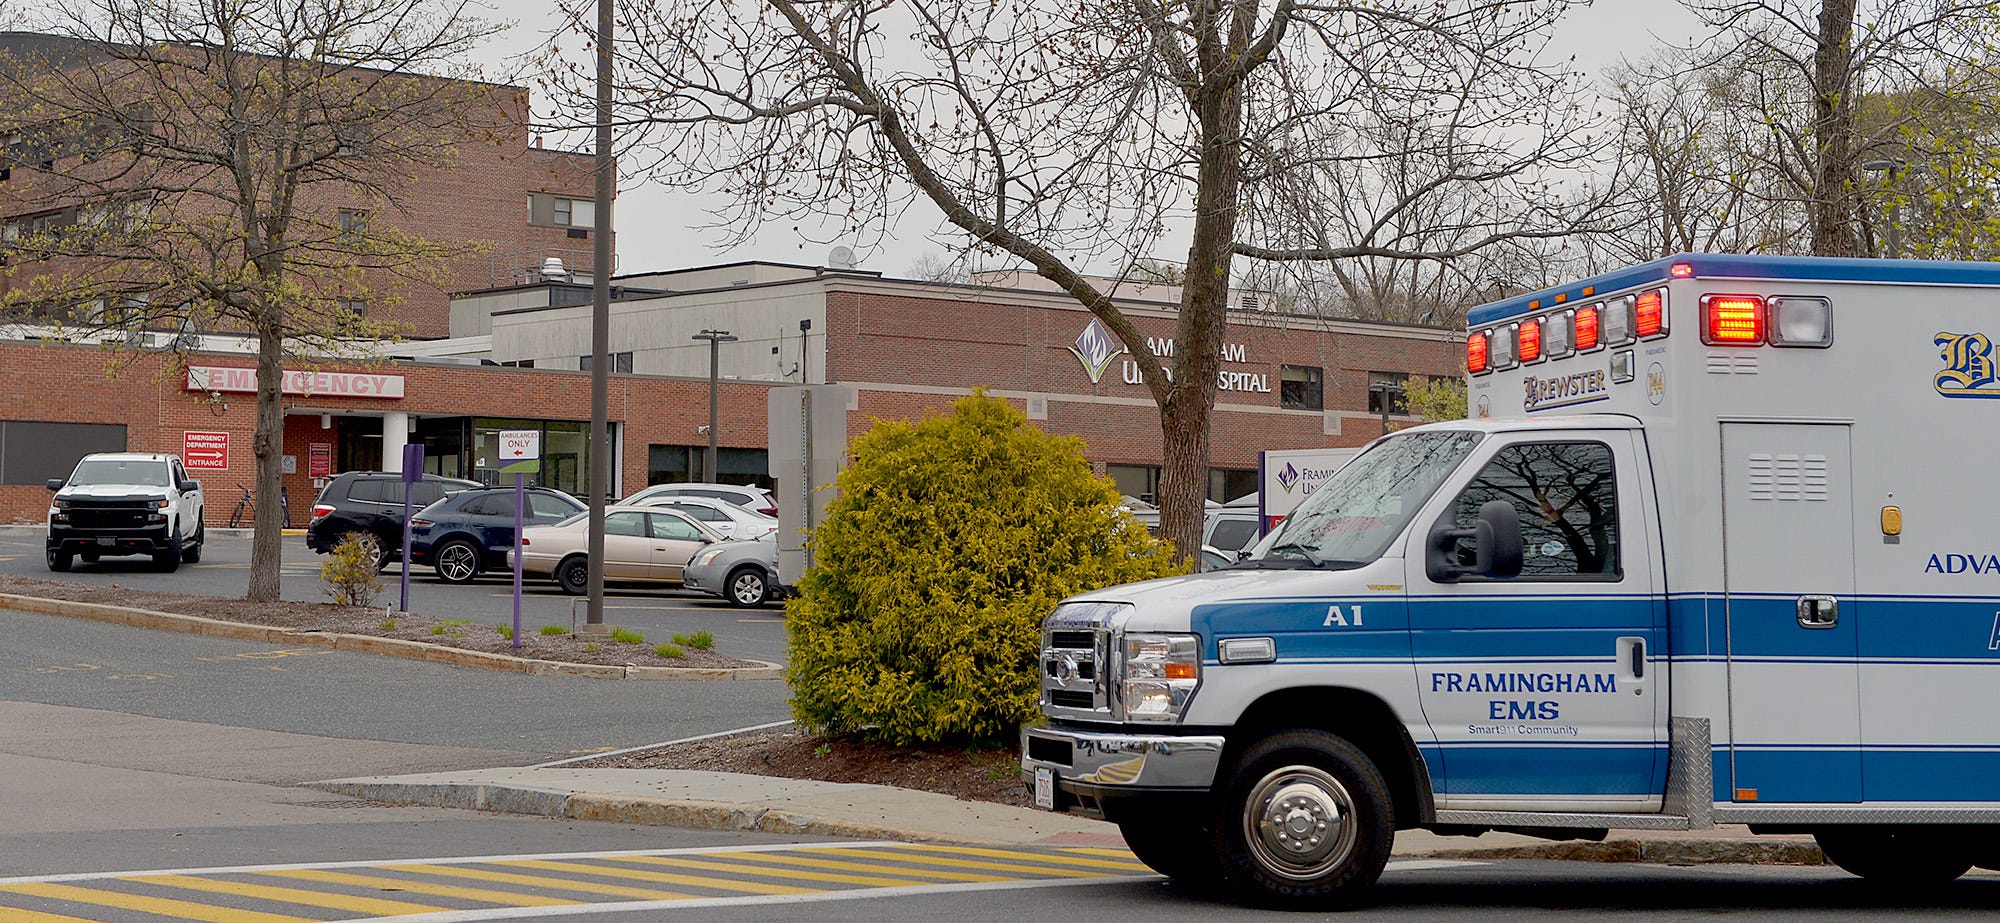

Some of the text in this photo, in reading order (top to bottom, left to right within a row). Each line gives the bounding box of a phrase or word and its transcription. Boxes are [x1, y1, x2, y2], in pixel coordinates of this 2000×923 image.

[1217, 371, 1271, 393] SPITAL
[1524, 370, 1606, 412] BREWSTER
[186, 441, 227, 449] DEPARTMENT
[187, 434, 226, 442] EMERGENCY
[507, 440, 530, 448] ONLY
[188, 459, 224, 467] ENTRANCE
[1322, 605, 1363, 626] A1
[1431, 673, 1617, 693] FRAMINGHAM
[1489, 701, 1560, 720] EMS
[1468, 724, 1578, 736] Smart911 Community
